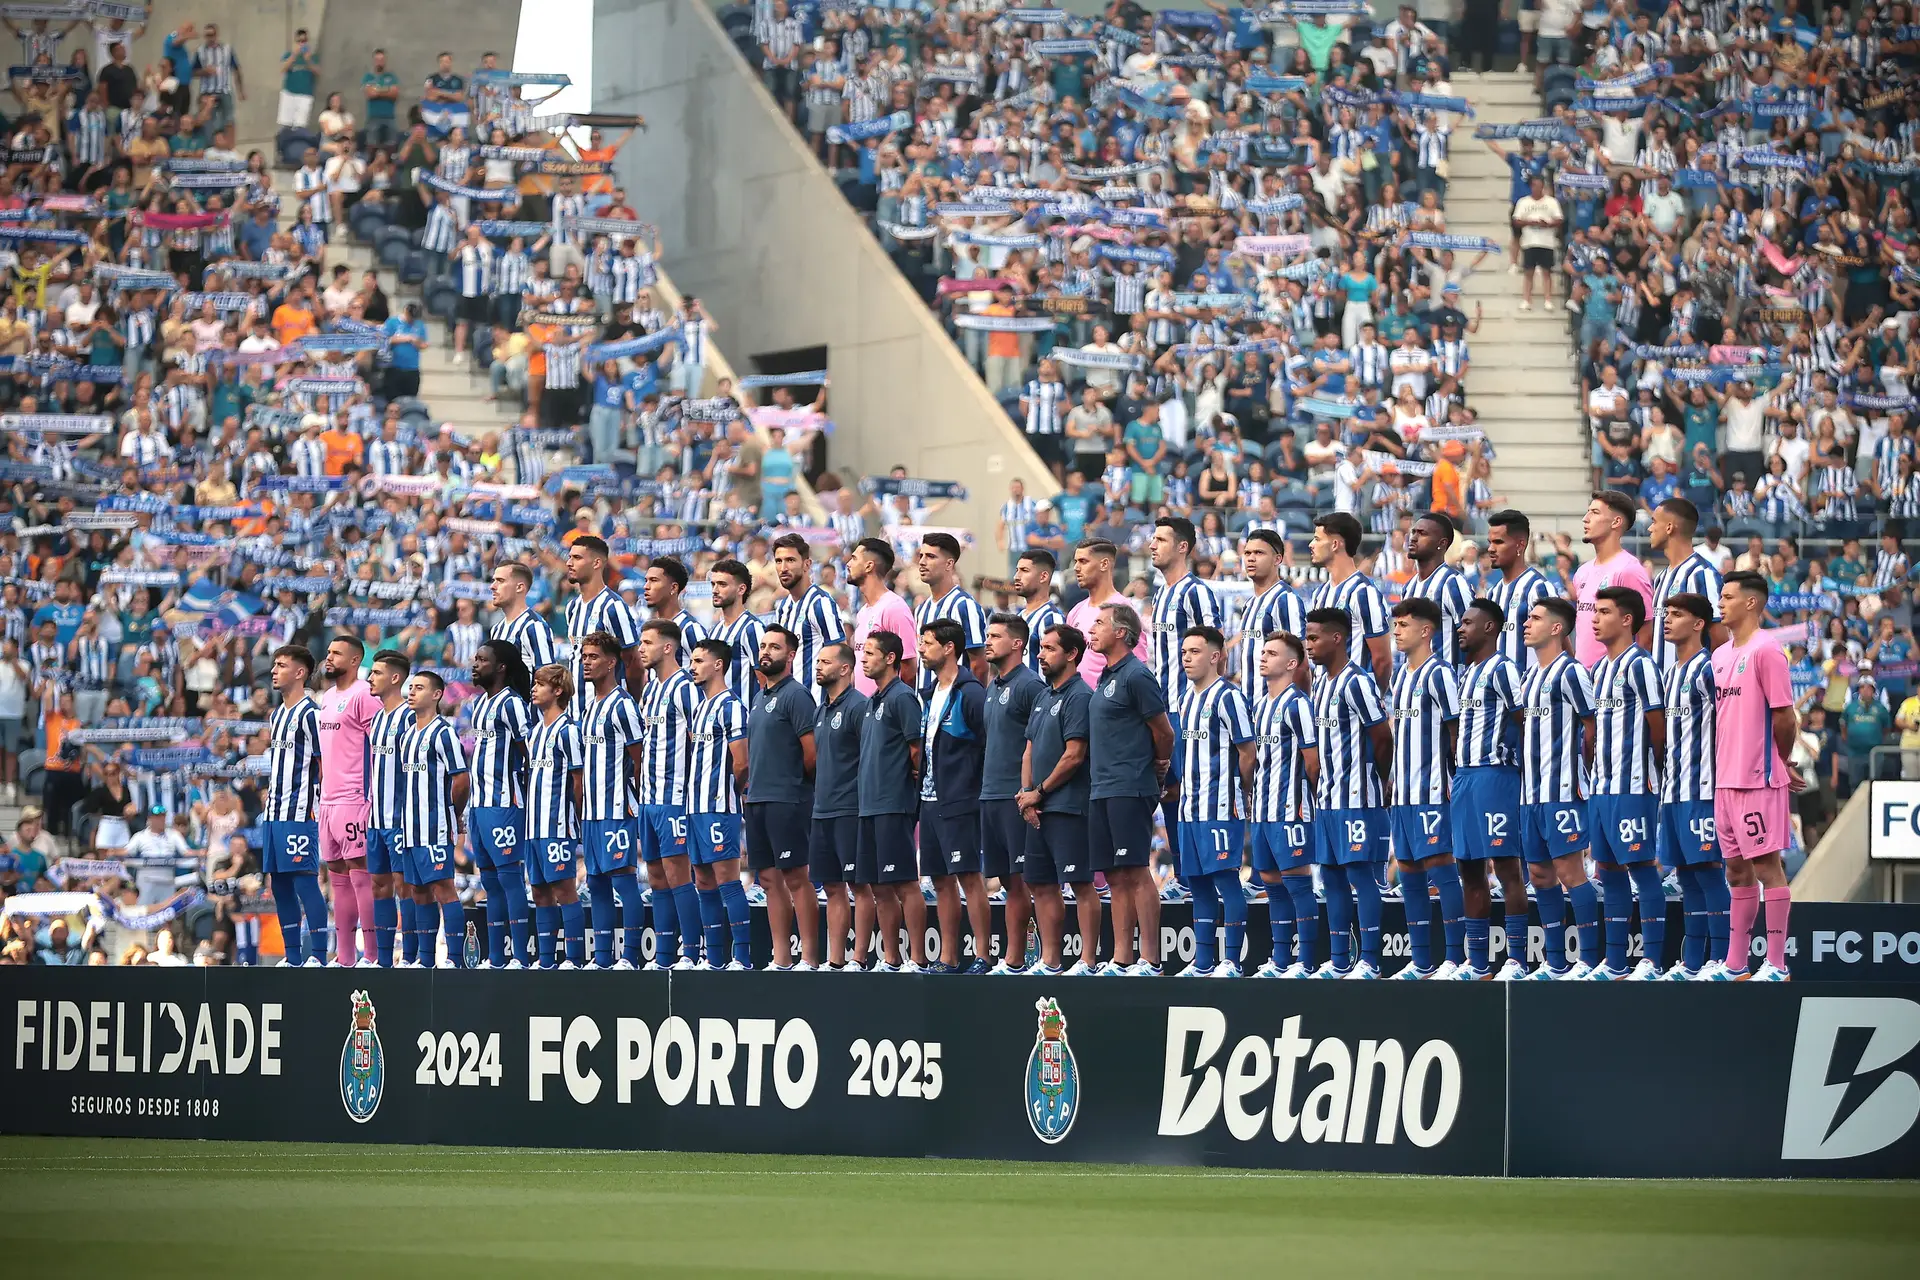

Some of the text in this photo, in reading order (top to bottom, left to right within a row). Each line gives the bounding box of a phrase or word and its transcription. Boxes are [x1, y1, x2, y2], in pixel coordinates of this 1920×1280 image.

[1595, 698, 1622, 708] BETANO
[1182, 730, 1209, 740] BETANO
[711, 822, 724, 843] 6
[1344, 819, 1366, 843] 18
[1419, 810, 1442, 834] 17
[1485, 812, 1507, 836] 12
[1555, 809, 1581, 834] 21
[1618, 816, 1646, 843] 84
[1743, 811, 1767, 837] 51
[286, 835, 310, 856] 52
[492, 825, 517, 848] 28
[604, 828, 630, 853] 70
[1210, 828, 1229, 852] 11
[1283, 823, 1306, 848] 10
[426, 843, 447, 864] 15
[547, 840, 571, 864] 86
[1382, 933, 1412, 957] 202
[1812, 930, 1863, 964] FC
[17, 1001, 282, 1075] FIDELIDADE
[416, 1016, 942, 1109] 2024 FC PORTO 2025
[1158, 1007, 1460, 1147] Betano
[72, 1096, 218, 1116] SEGUROS DESDE 1808
